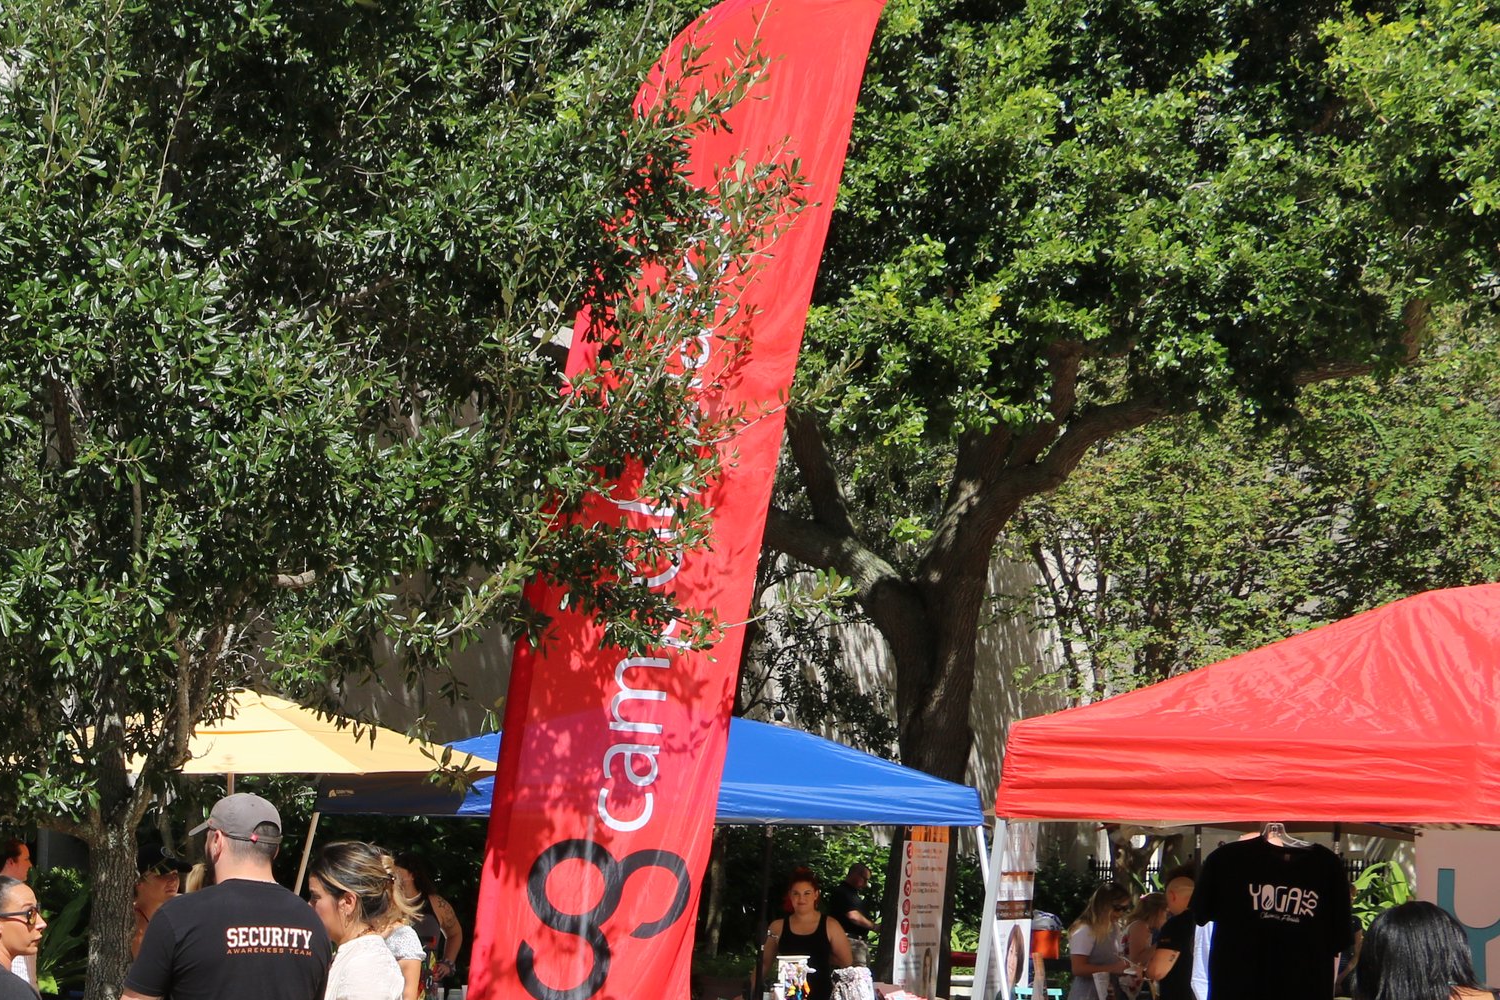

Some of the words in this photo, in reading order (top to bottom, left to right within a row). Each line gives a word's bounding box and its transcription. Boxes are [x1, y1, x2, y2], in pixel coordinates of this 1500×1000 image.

[1249, 883, 1303, 915] YOGA
[1299, 889, 1319, 917] 365
[226, 927, 313, 949] SECURITY
[226, 947, 285, 955] AWARENESS
[288, 948, 312, 957] TEAM
